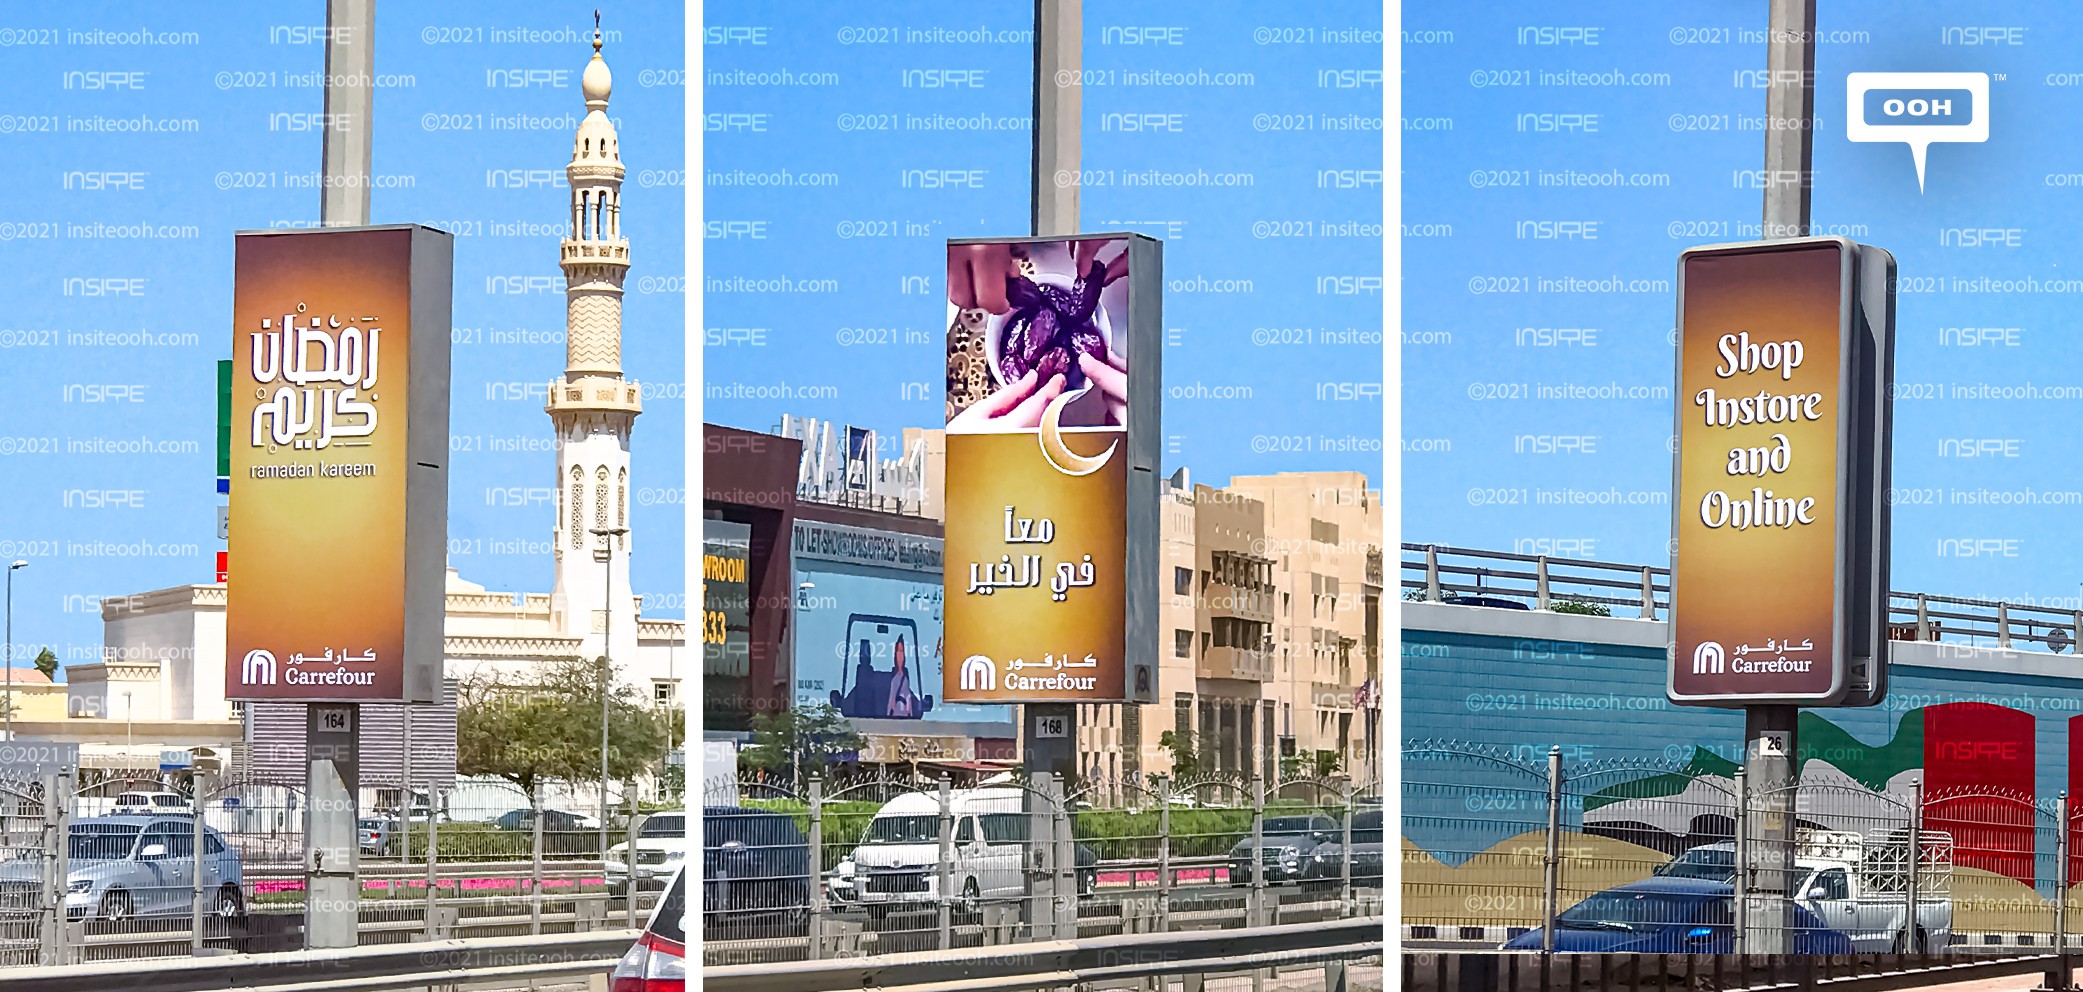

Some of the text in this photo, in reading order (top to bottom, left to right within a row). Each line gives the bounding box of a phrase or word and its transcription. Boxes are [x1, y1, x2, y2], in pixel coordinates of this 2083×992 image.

[250, 314, 382, 390] رمضان
[1716, 331, 1804, 380] Shop
[252, 386, 379, 449] كريم
[1695, 388, 1823, 429] Instore
[1726, 433, 1792, 477] and
[250, 460, 377, 479] ramadan kareem
[1700, 487, 1816, 530] Online
[966, 554, 1042, 594] الخير
[1050, 554, 1096, 601] في
[286, 646, 377, 665] كارفور
[1733, 638, 1813, 655] كارفور
[1005, 652, 1097, 670] كارفور
[1731, 656, 1812, 673] Carrefour
[285, 666, 376, 685] Carrefour
[1004, 672, 1097, 690] Carrefour
[324, 713, 345, 729] 164
[1042, 719, 1062, 734] 168
[1767, 736, 1782, 750] 26
